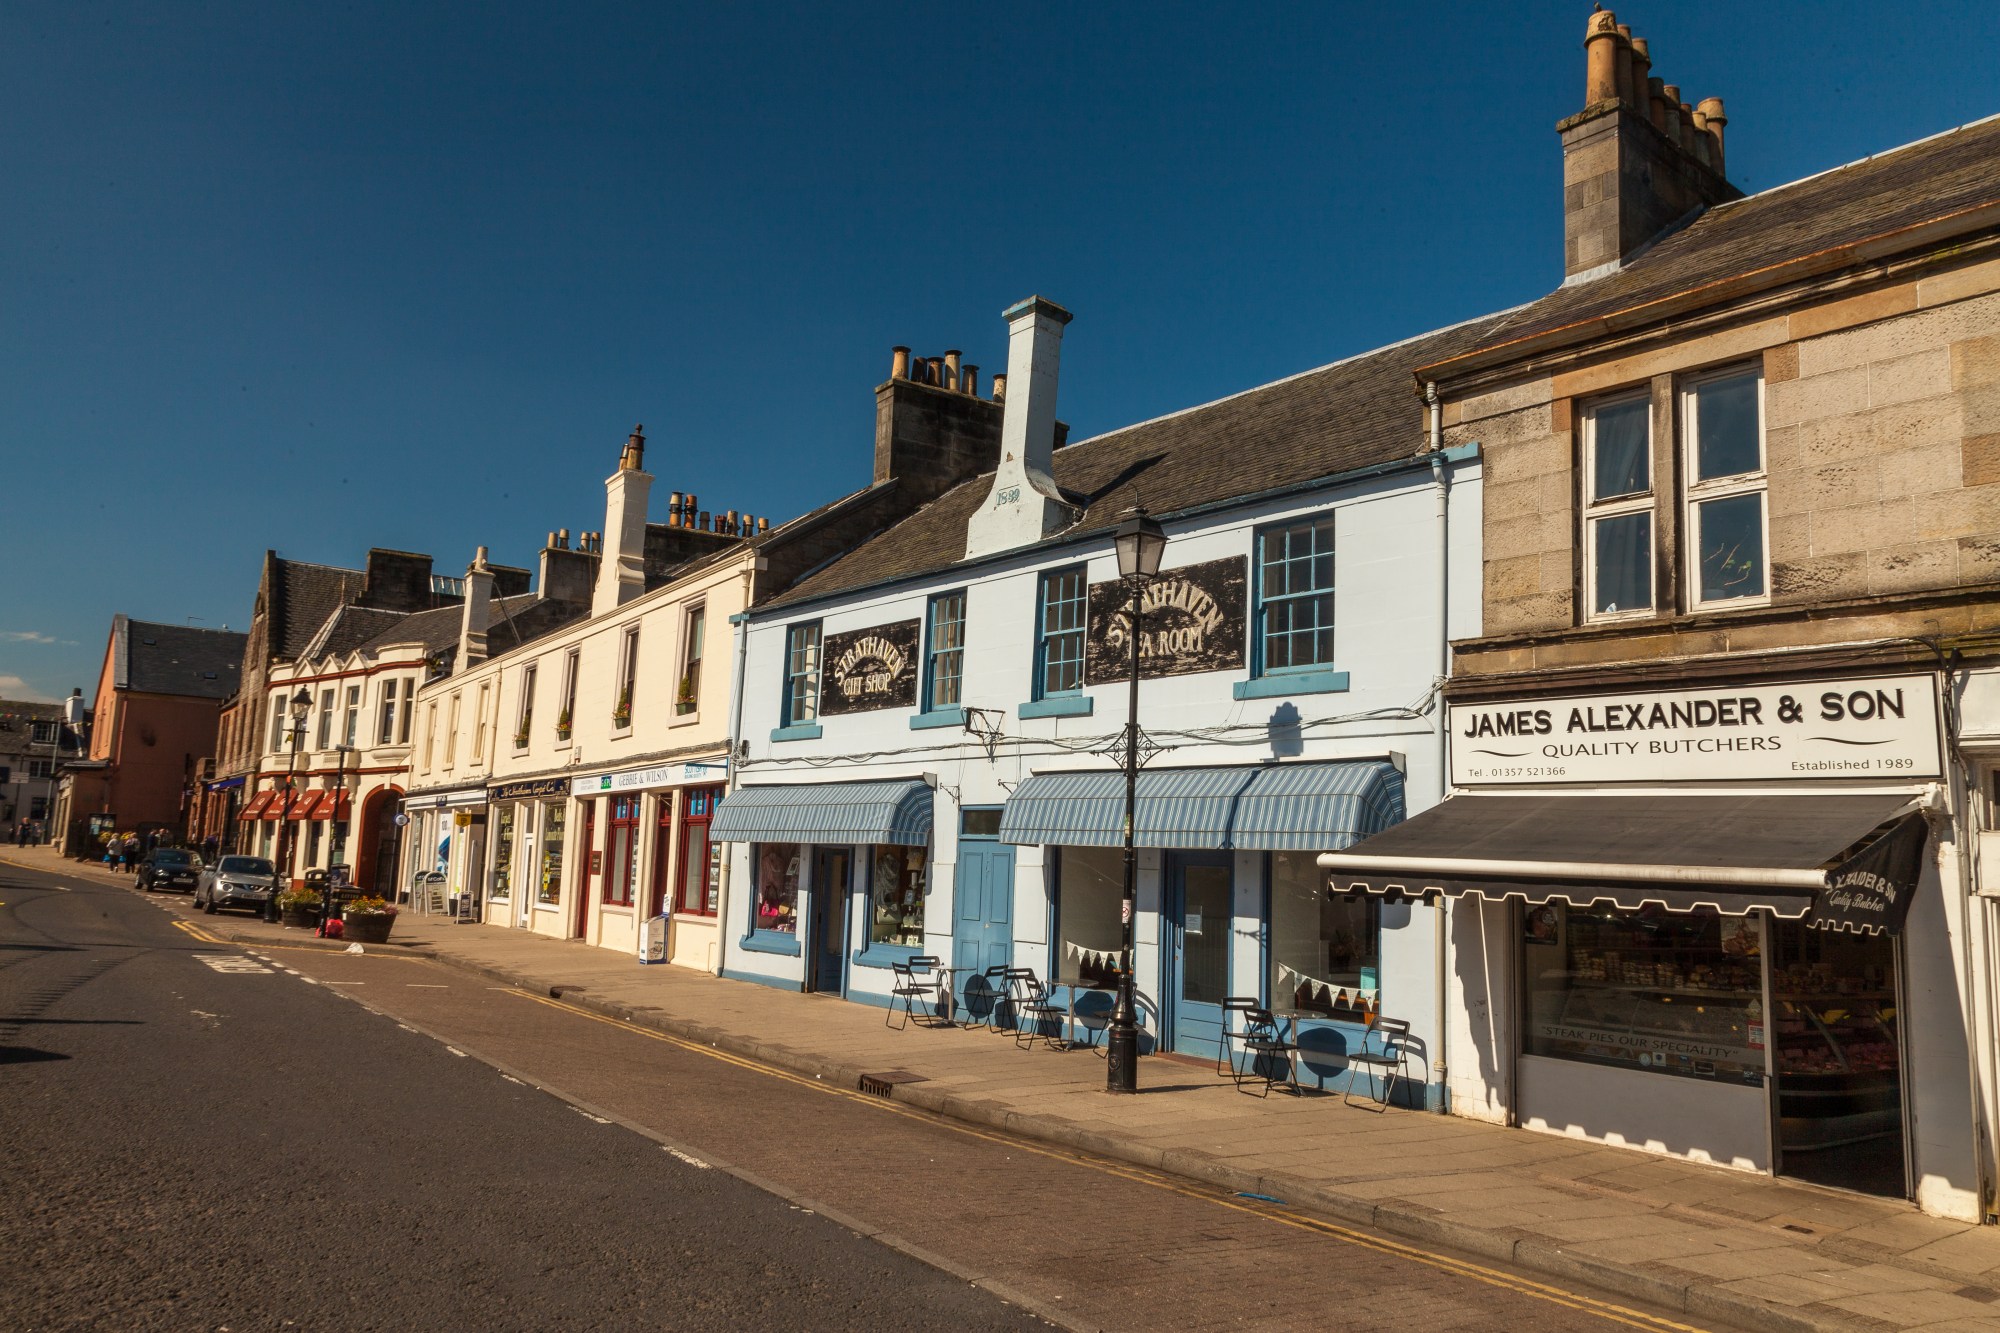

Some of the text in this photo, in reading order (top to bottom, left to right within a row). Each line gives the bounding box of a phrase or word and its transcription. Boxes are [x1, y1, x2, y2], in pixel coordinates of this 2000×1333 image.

[1108, 580, 1224, 648] STATHAVEN
[1158, 626, 1204, 655] ROOM
[835, 636, 904, 686] STRATHAVEN
[844, 672, 891, 695] GIFT SHOP
[1464, 688, 1906, 738] JAMES ALEXANDER & SON
[1542, 736, 1782, 758] QUALITY BUTCHERS
[1491, 768, 1523, 777] 01357
[1527, 766, 1566, 776] 521366
[1791, 758, 1914, 771] Established 1989
[618, 769, 669, 787] GEBBIE & WILSON
[1829, 890, 1851, 912] Quality
[1876, 878, 1886, 893] &
[1885, 882, 1896, 904] SN
[1589, 1033, 1614, 1043] PIES
[1619, 1036, 1648, 1048] OUR
